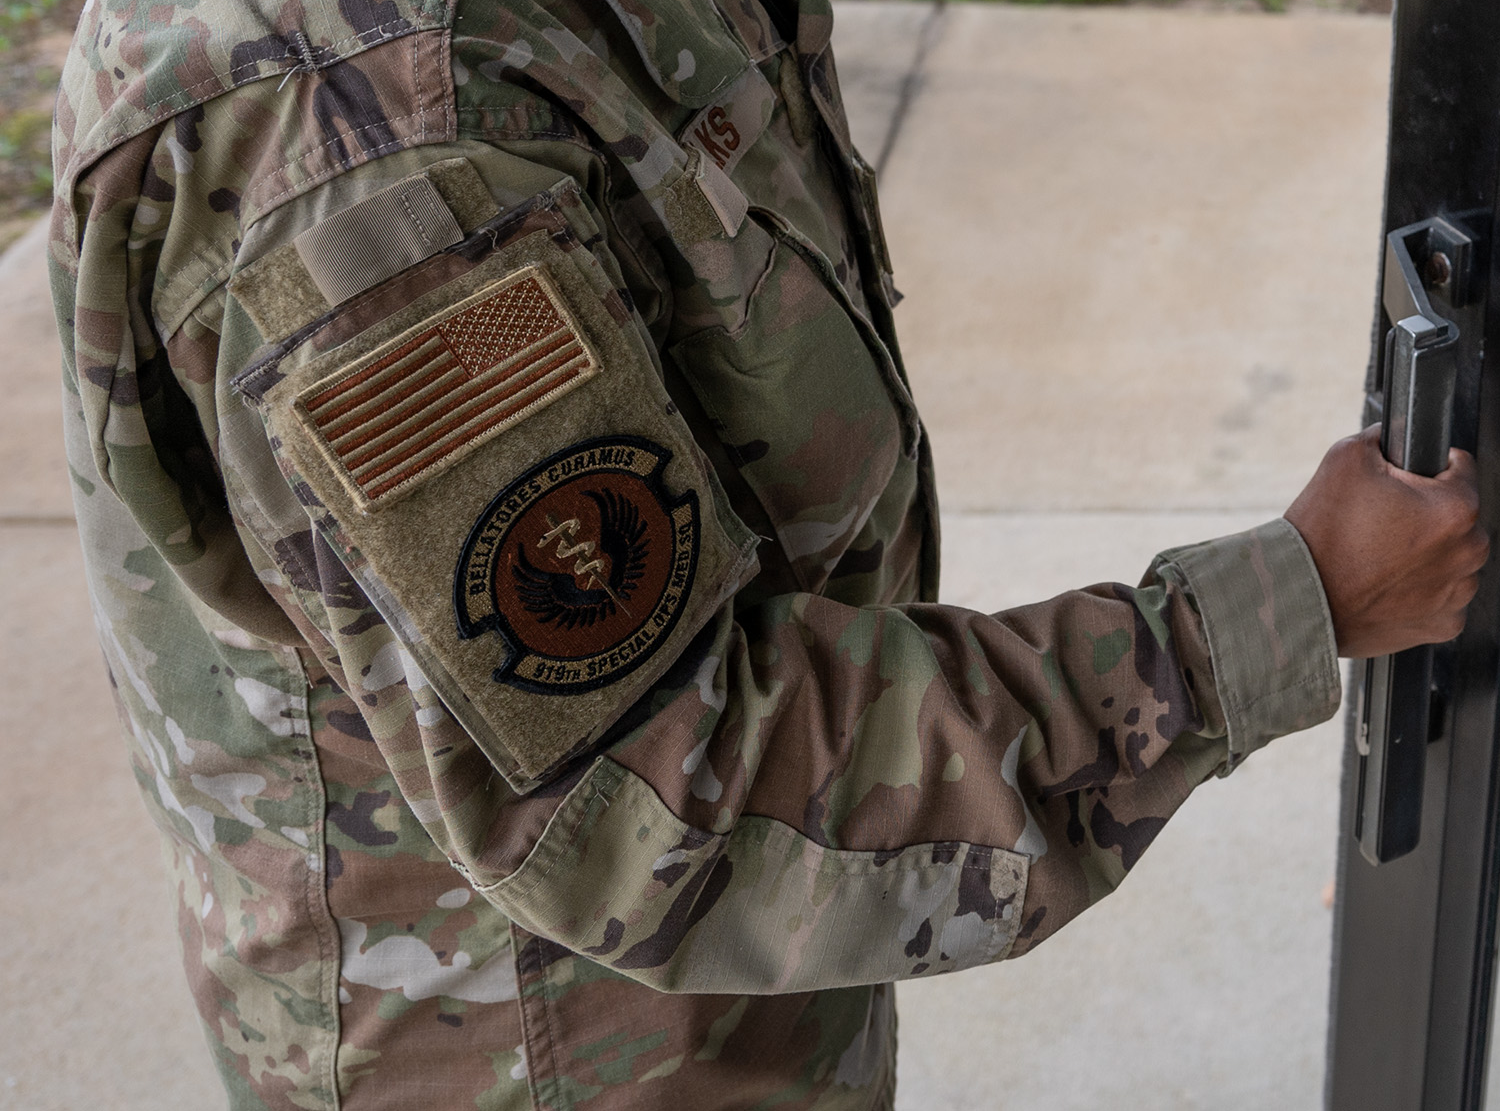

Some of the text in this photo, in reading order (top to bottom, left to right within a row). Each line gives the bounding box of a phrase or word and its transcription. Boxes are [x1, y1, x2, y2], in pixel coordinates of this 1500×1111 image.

[694, 105, 741, 171] KS
[468, 447, 637, 596] BELLATORES CURAMUS
[678, 521, 693, 548] SQ
[671, 550, 691, 589] MED
[654, 592, 679, 628] OPS
[586, 630, 657, 678] SPECIAL
